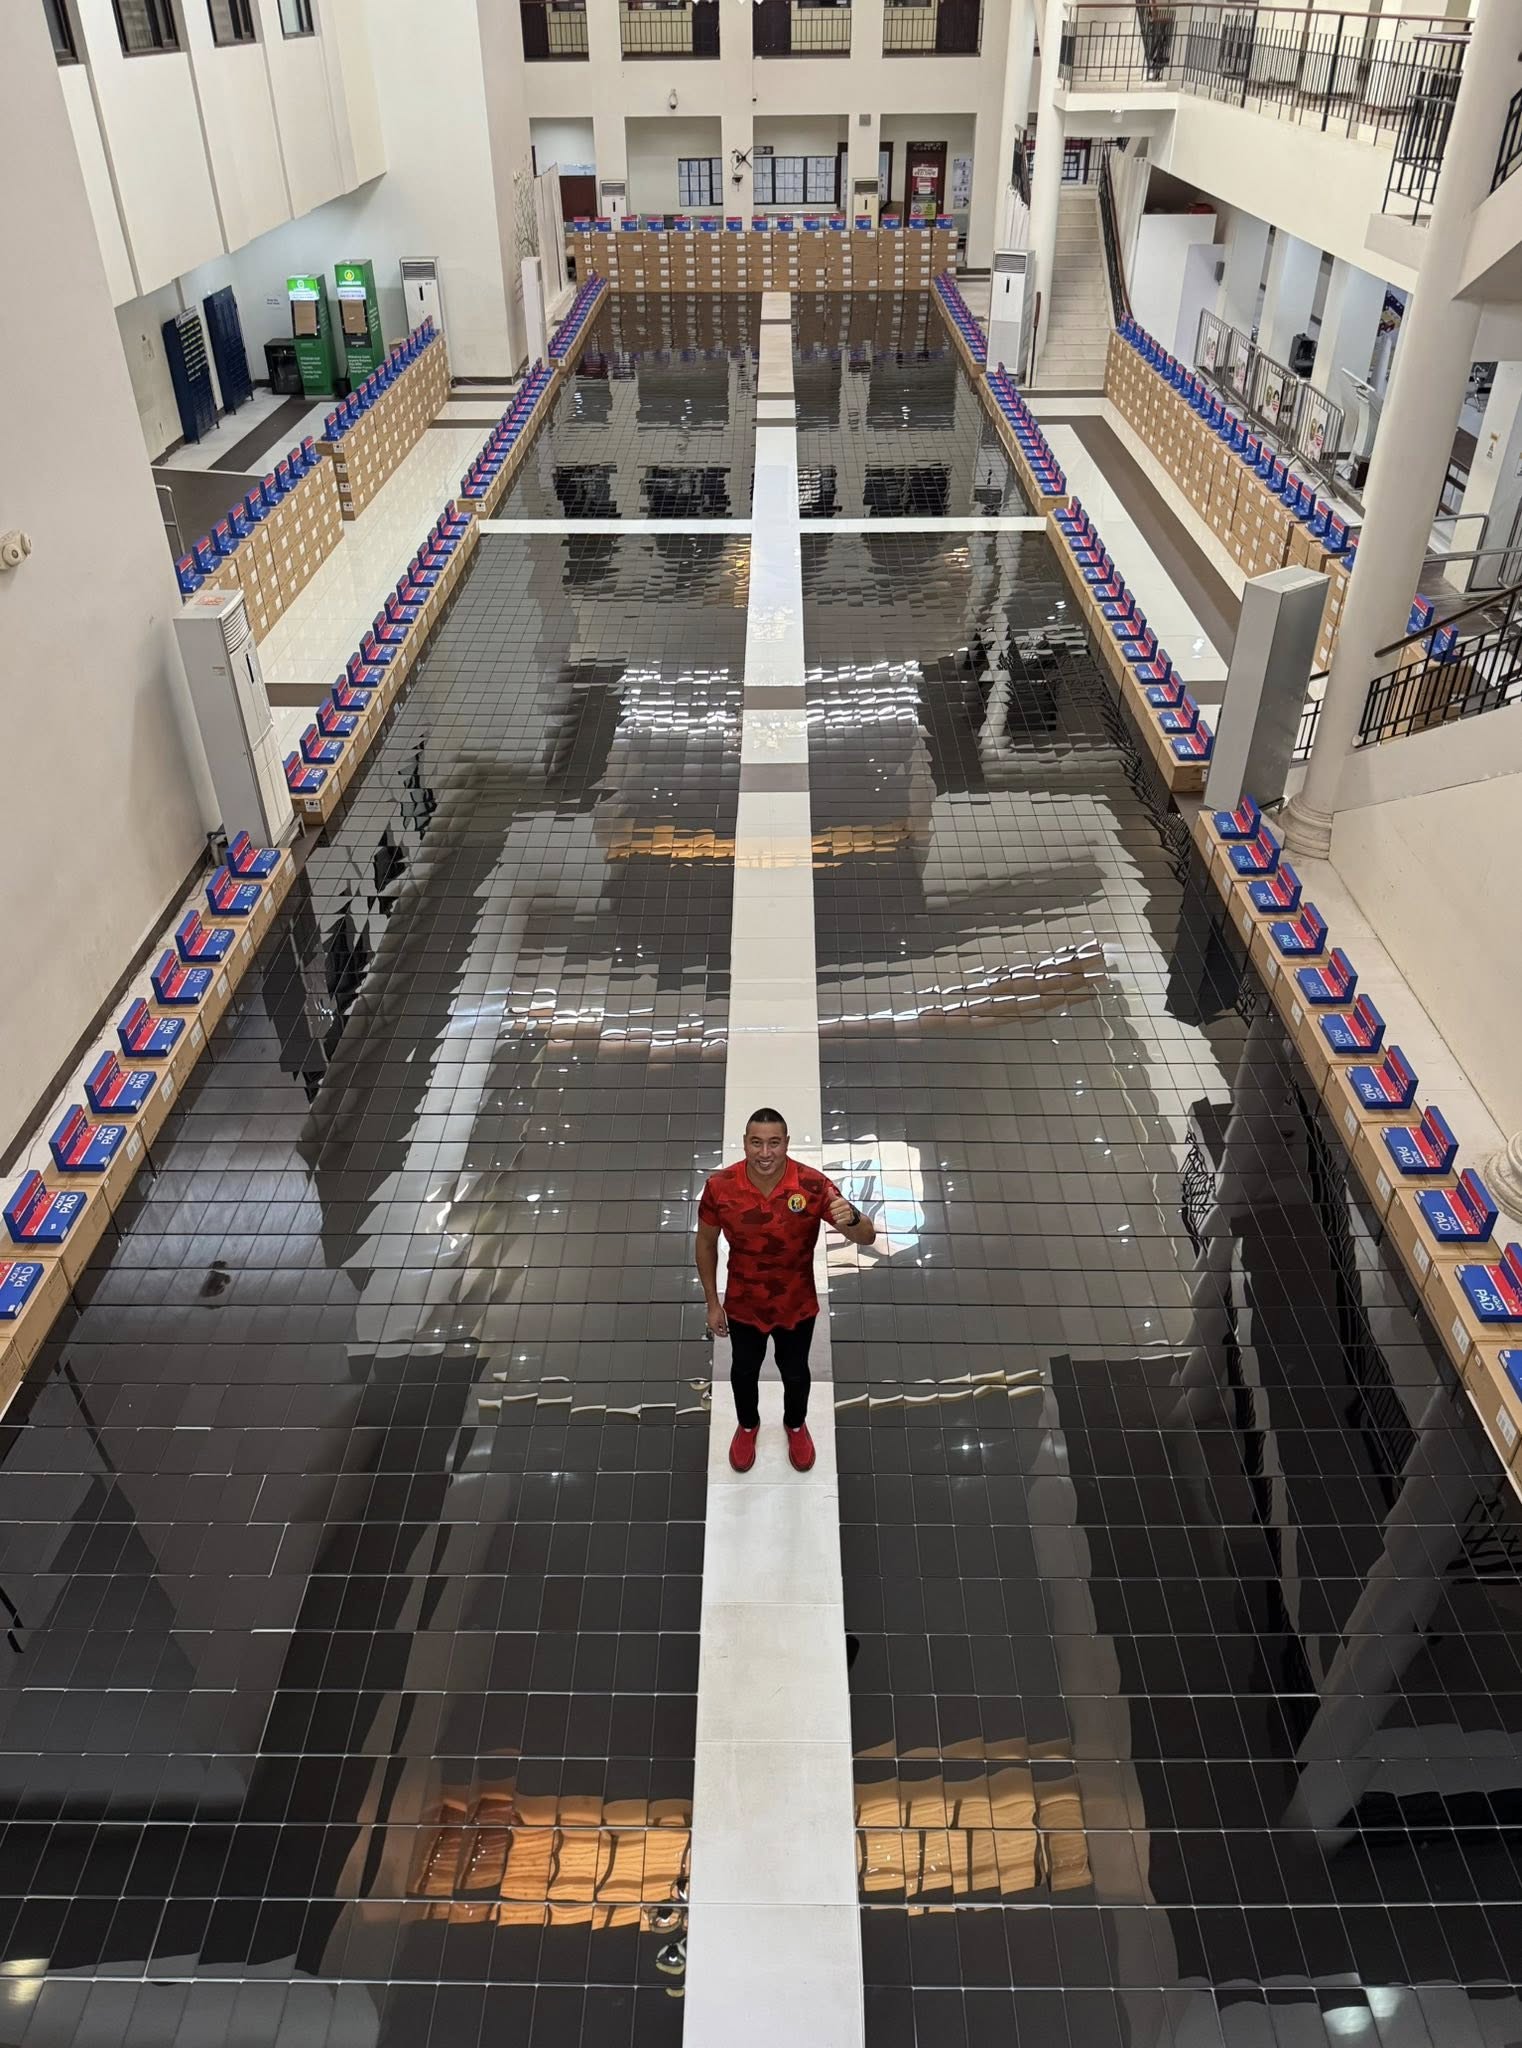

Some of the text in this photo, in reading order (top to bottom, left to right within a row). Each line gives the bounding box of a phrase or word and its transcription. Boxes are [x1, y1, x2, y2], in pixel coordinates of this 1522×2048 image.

[1280, 934, 1293, 947] PAD
[193, 969, 207, 983] PAD
[163, 1019, 178, 1034] PAD
[1331, 1029, 1346, 1044] PAD
[133, 1073, 149, 1089] PAD
[1360, 1083, 1377, 1099] PAD
[97, 1127, 108, 1140] AQUA
[101, 1127, 118, 1145] PAD
[1397, 1146, 1414, 1164] PAD
[1411, 1150, 1422, 1164] AQUA
[55, 1194, 67, 1209] AQUA
[60, 1194, 78, 1214] PAD
[1432, 1211, 1451, 1231] PAD
[1448, 1216, 1460, 1231] AQUA
[9, 1266, 22, 1282] AQUA
[13, 1266, 34, 1287] PAD
[1474, 1289, 1495, 1311] PAD
[1489, 1294, 1504, 1312] AQUA
